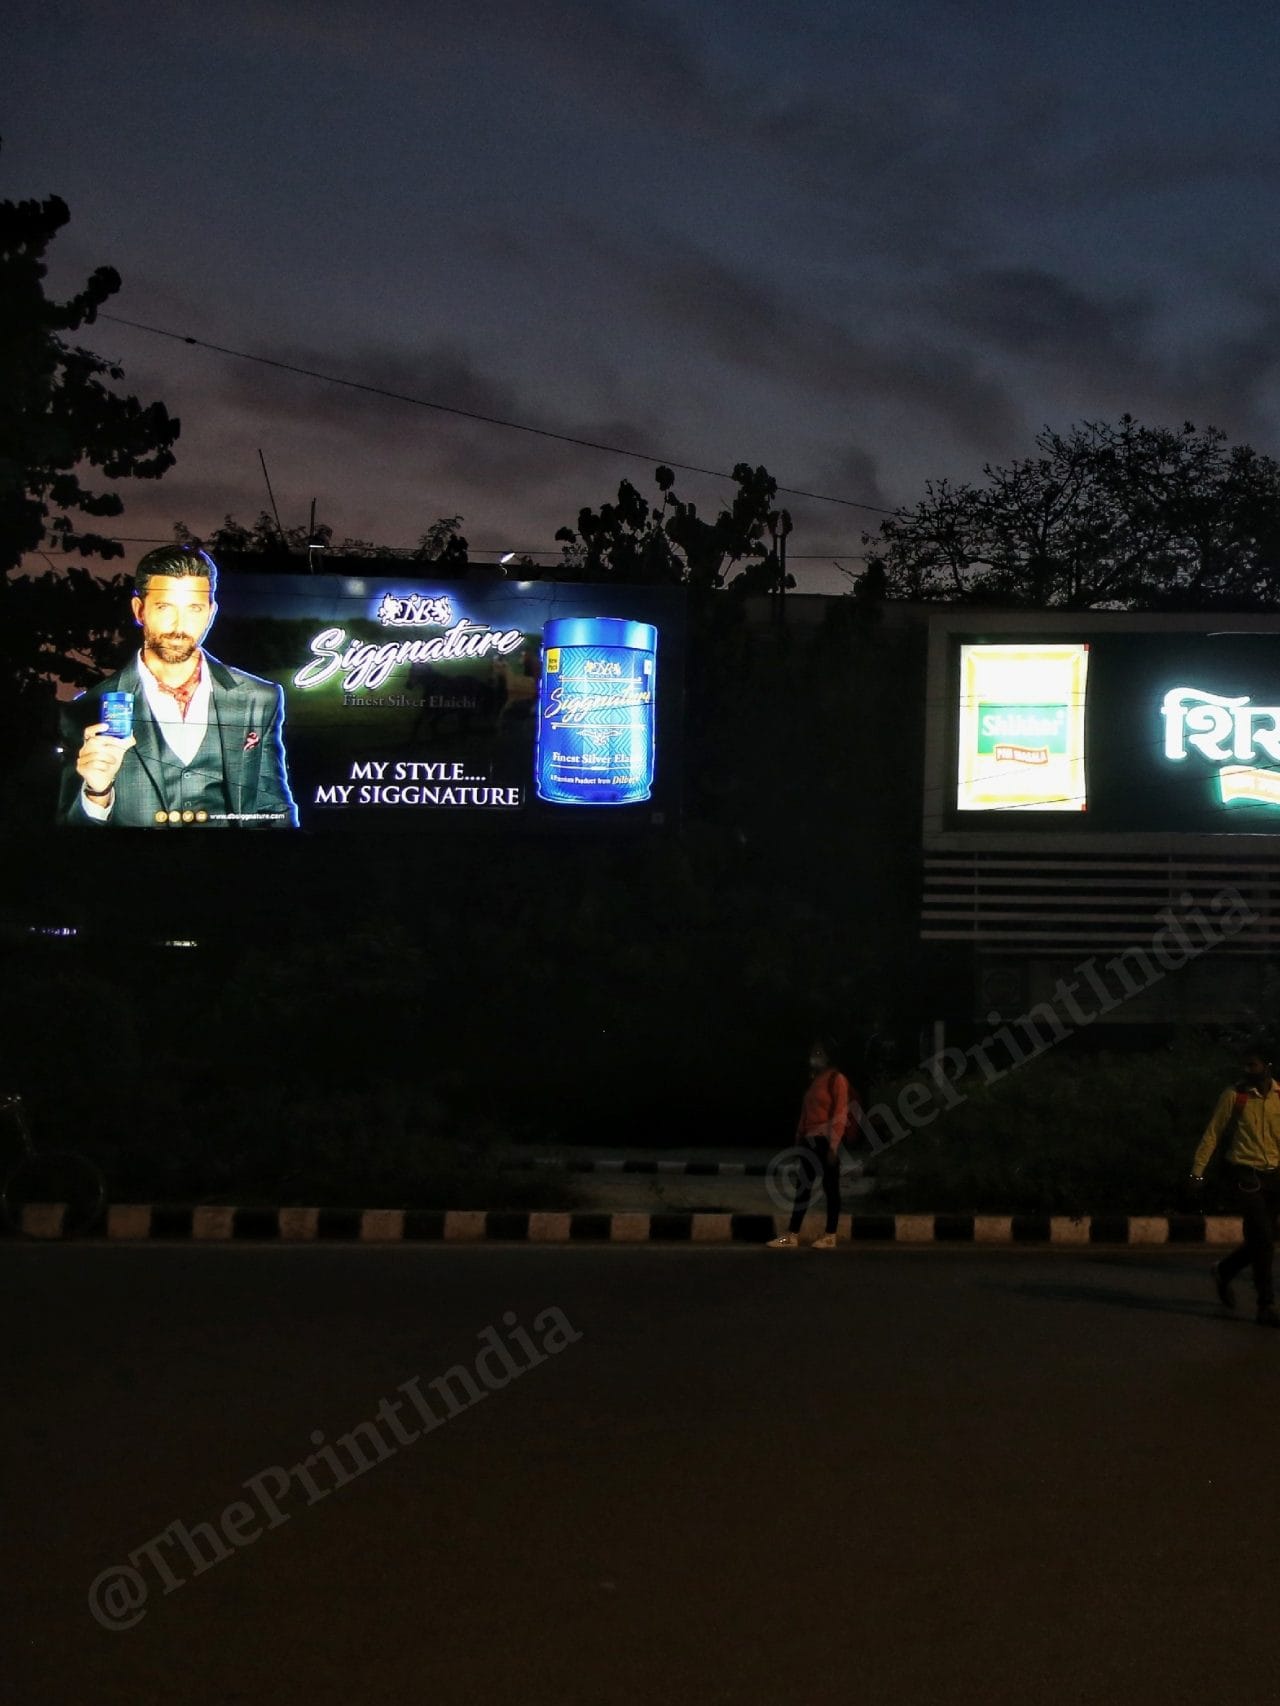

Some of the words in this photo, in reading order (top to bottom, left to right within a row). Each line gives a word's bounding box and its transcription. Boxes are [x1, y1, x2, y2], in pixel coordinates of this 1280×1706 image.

[293, 619, 525, 692] Siggnature
[343, 694, 385, 706] Finest
[350, 761, 389, 780] MY
[314, 785, 354, 803] MY
[359, 785, 519, 806] SIGGNATURE
